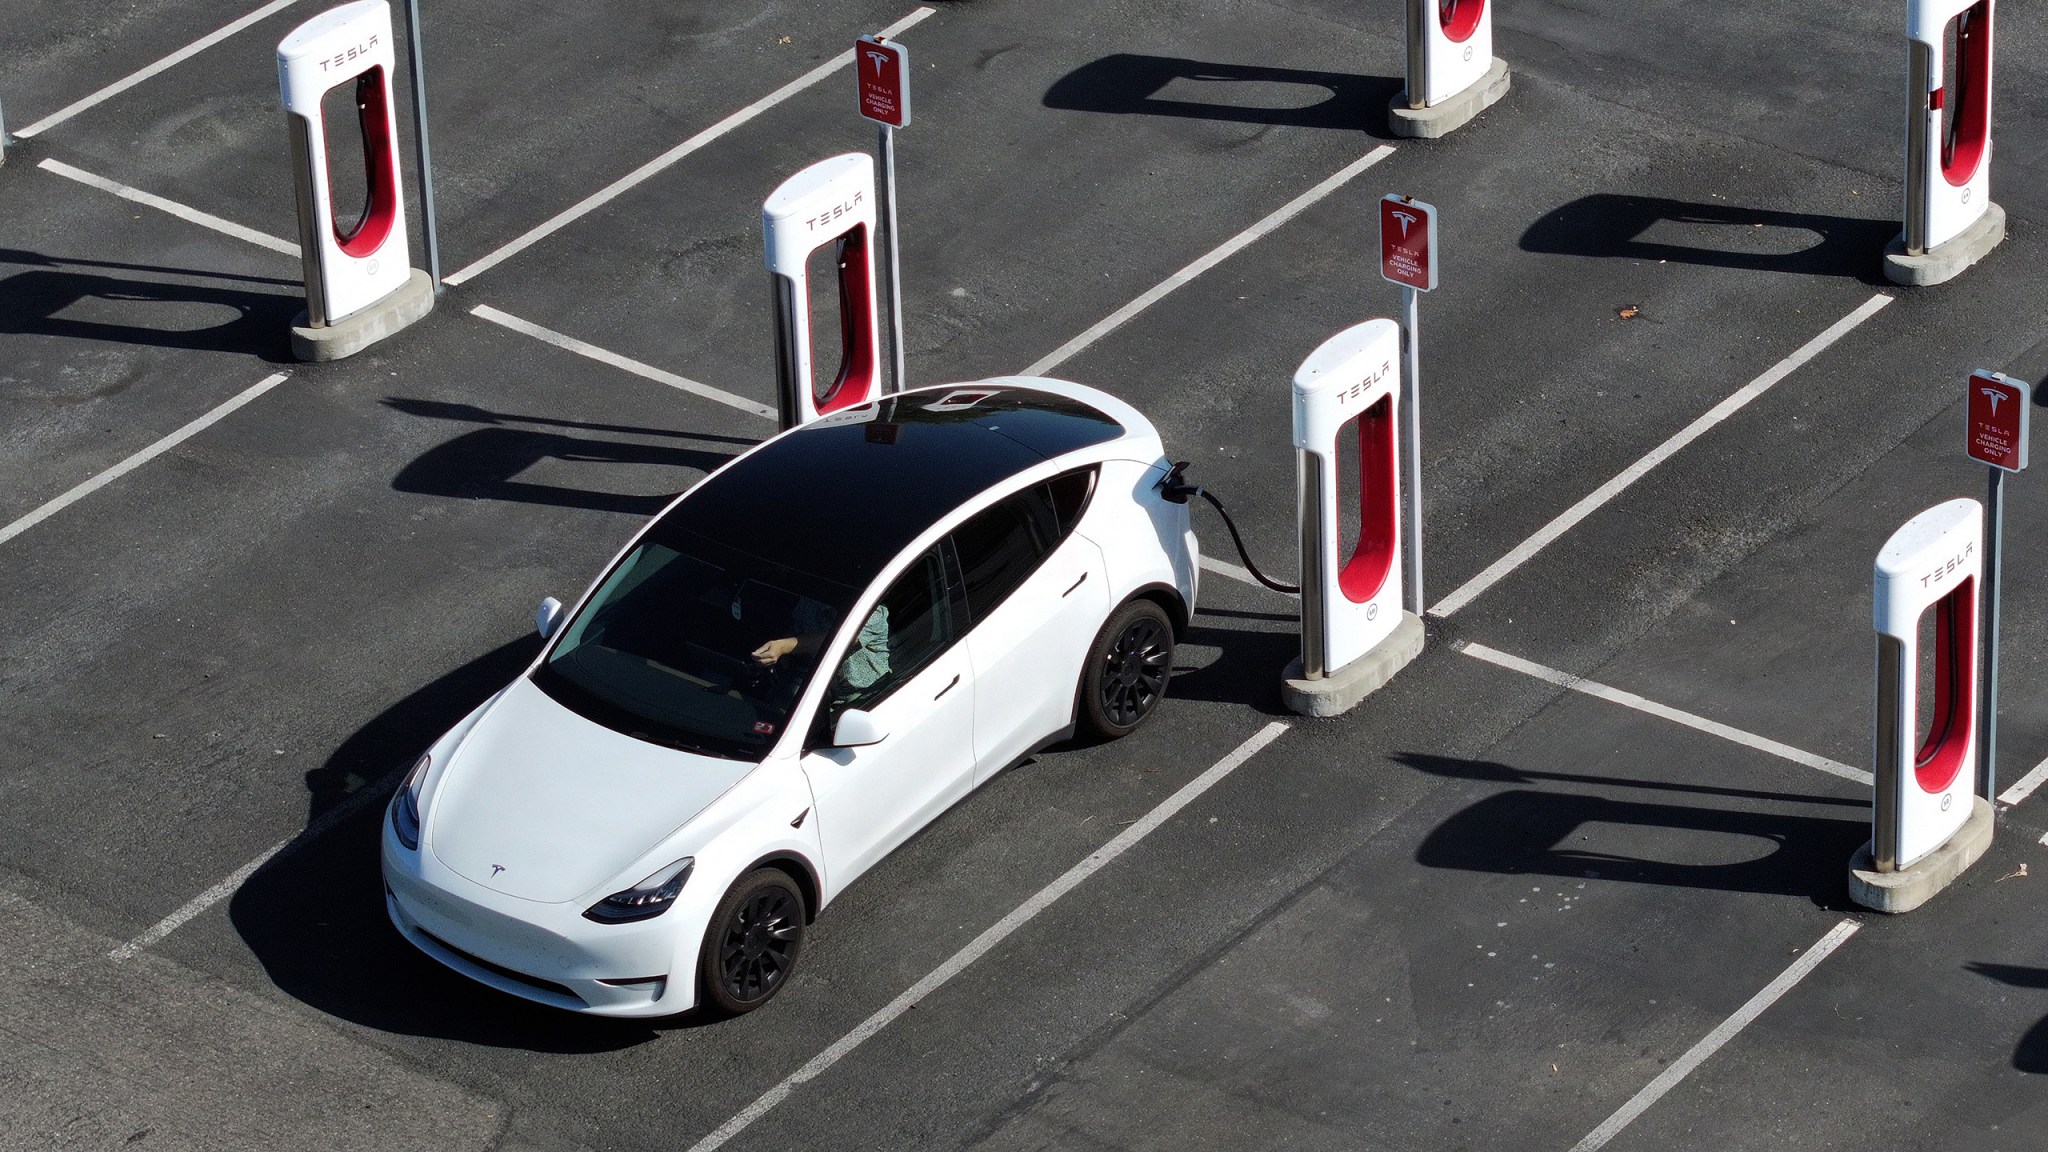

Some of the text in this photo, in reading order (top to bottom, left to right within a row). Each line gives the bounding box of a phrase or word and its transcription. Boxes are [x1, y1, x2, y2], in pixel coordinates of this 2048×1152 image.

[319, 34, 378, 72] TESLA
[867, 82, 893, 95] TESLA
[865, 98, 896, 112] CHARGING
[868, 92, 892, 105] VEHICLE
[873, 106, 889, 116] ONLY
[805, 190, 863, 231] TESLA
[1390, 244, 1420, 257] TESLA
[1389, 259, 1422, 274] CHARGING
[1392, 254, 1418, 267] VEHICLE
[1396, 268, 1415, 278] ONLY
[1336, 360, 1390, 404] TESLA
[1978, 422, 2010, 436] TESLA
[1975, 438, 2012, 454] CHARGING
[1979, 432, 2008, 446] VEHICLE
[1983, 447, 2003, 458] ONLY
[1920, 540, 1973, 588] TESLA
